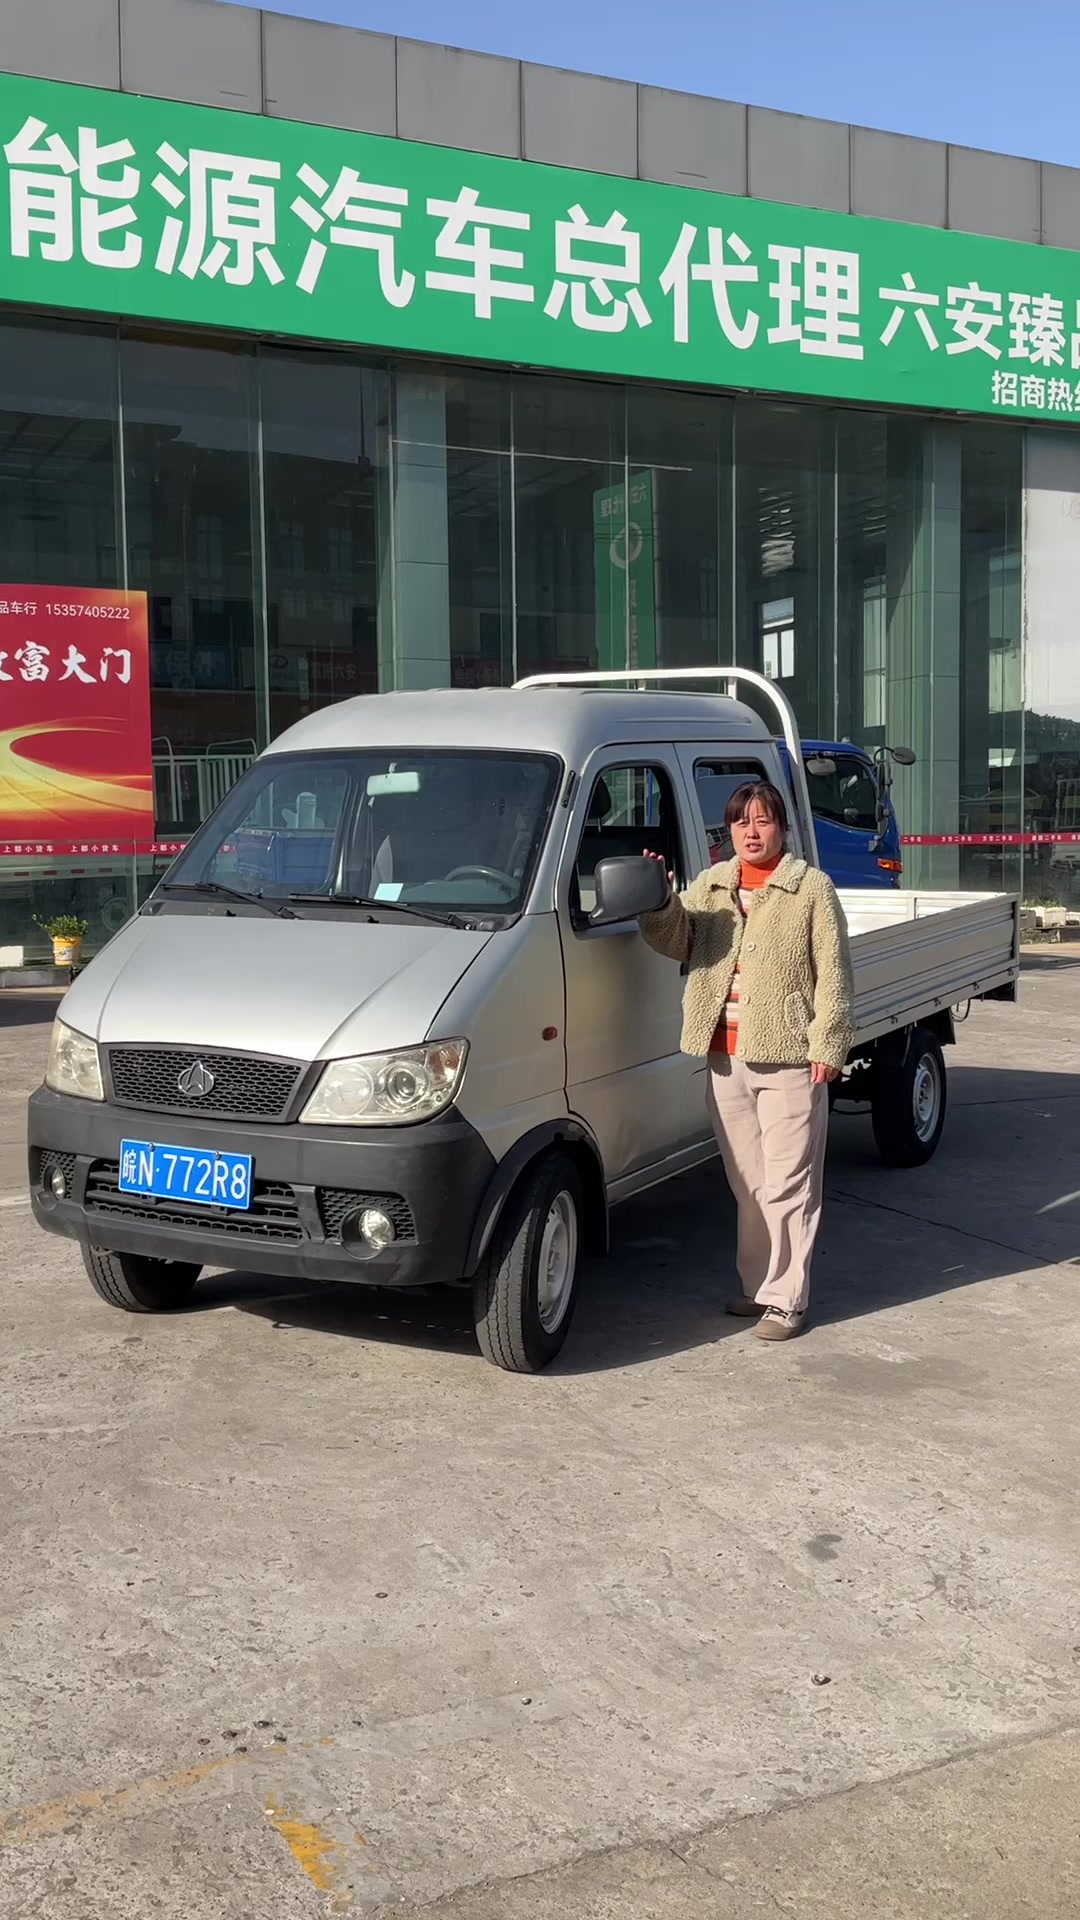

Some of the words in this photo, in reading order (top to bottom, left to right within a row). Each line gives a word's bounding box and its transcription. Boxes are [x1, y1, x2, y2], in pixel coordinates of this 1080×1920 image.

[3, 115, 864, 361] 能源汽车总代理
[879, 271, 1080, 369] 六安臻
[991, 370, 1080, 412] 招商热
[45, 603, 130, 619] 15357405222
